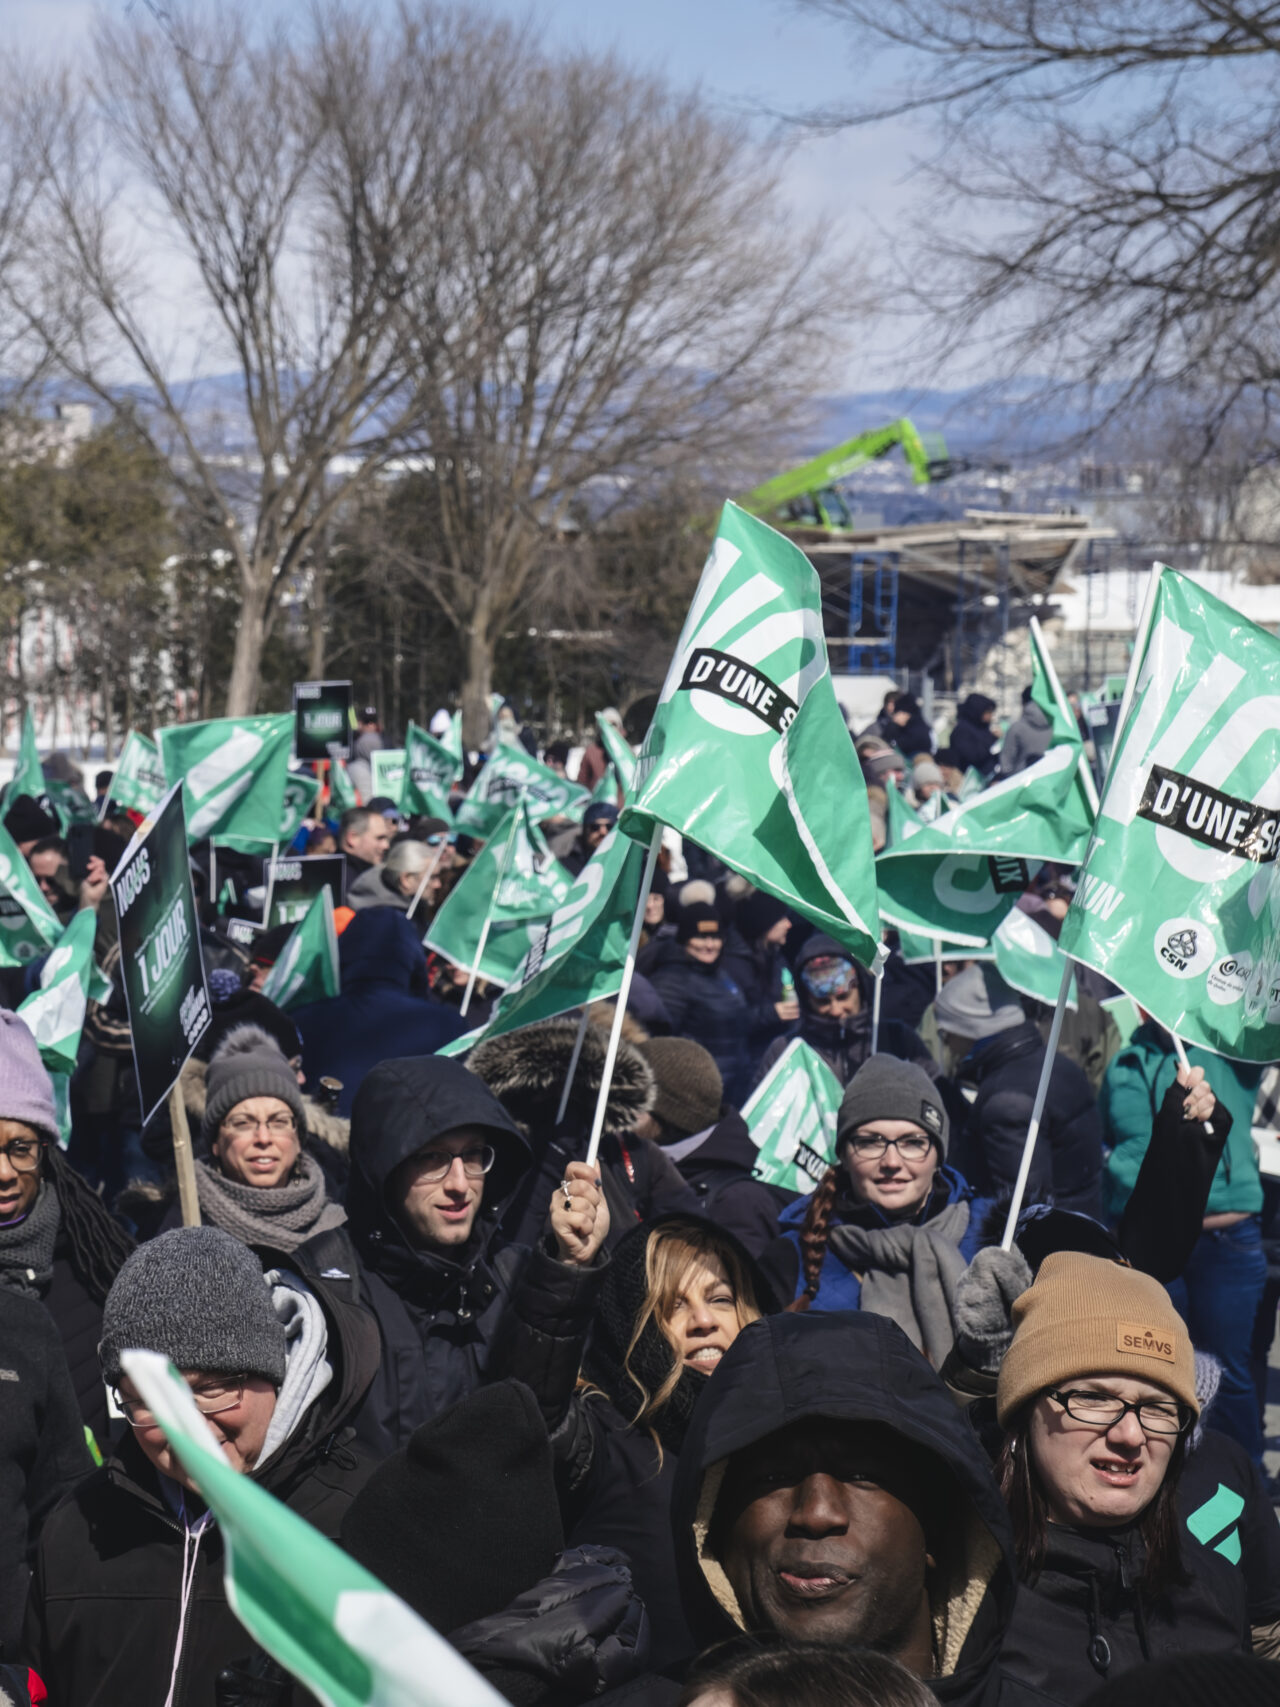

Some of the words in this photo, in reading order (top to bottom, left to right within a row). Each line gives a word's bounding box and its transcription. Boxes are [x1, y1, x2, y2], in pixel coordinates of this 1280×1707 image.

[689, 655, 778, 716] D'UNE
[1152, 778, 1251, 848] D'UNE
[1160, 947, 1188, 971] CSN
[1123, 1335, 1172, 1355] SEMVS
